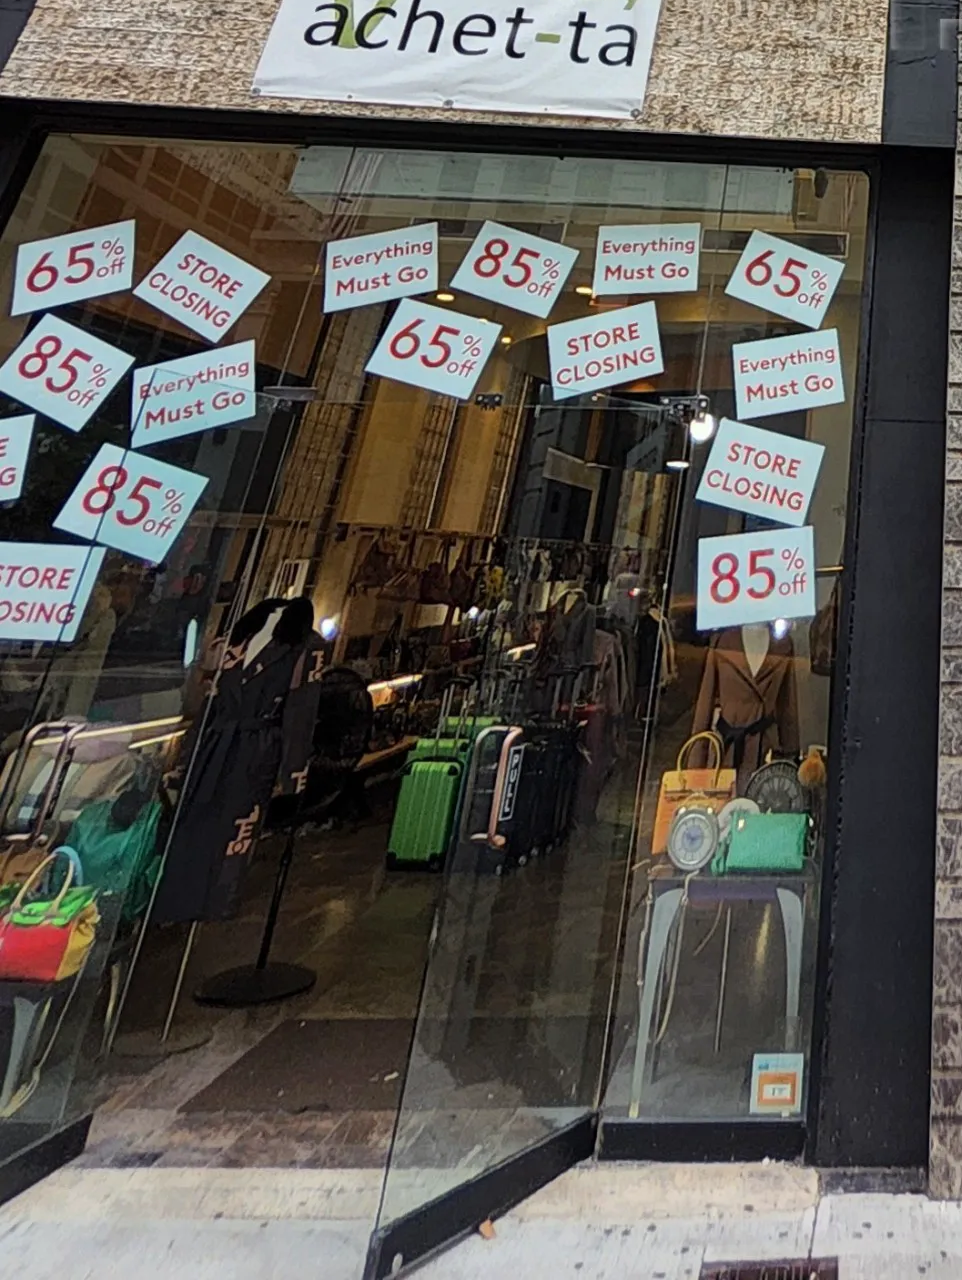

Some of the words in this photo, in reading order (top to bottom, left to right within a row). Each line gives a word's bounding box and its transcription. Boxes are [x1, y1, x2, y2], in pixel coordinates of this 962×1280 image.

[331, 240, 433, 269] Everything
[602, 237, 696, 255] Everything
[177, 253, 243, 300] STORE
[335, 272, 391, 296] Must
[397, 266, 429, 283] Go
[604, 265, 655, 281] Must
[661, 262, 689, 279] Go
[149, 272, 231, 328] CLOSING
[567, 322, 640, 356] STORE
[556, 346, 656, 386] CLOSING
[739, 348, 836, 374] Everything
[140, 362, 250, 399] Everything
[746, 379, 798, 403] Must
[805, 375, 834, 393] Go
[144, 401, 205, 429] Must
[213, 391, 246, 411] Go
[727, 442, 801, 479] STORE
[707, 469, 804, 511] CLOSING
[504, 754, 520, 813] PULL
